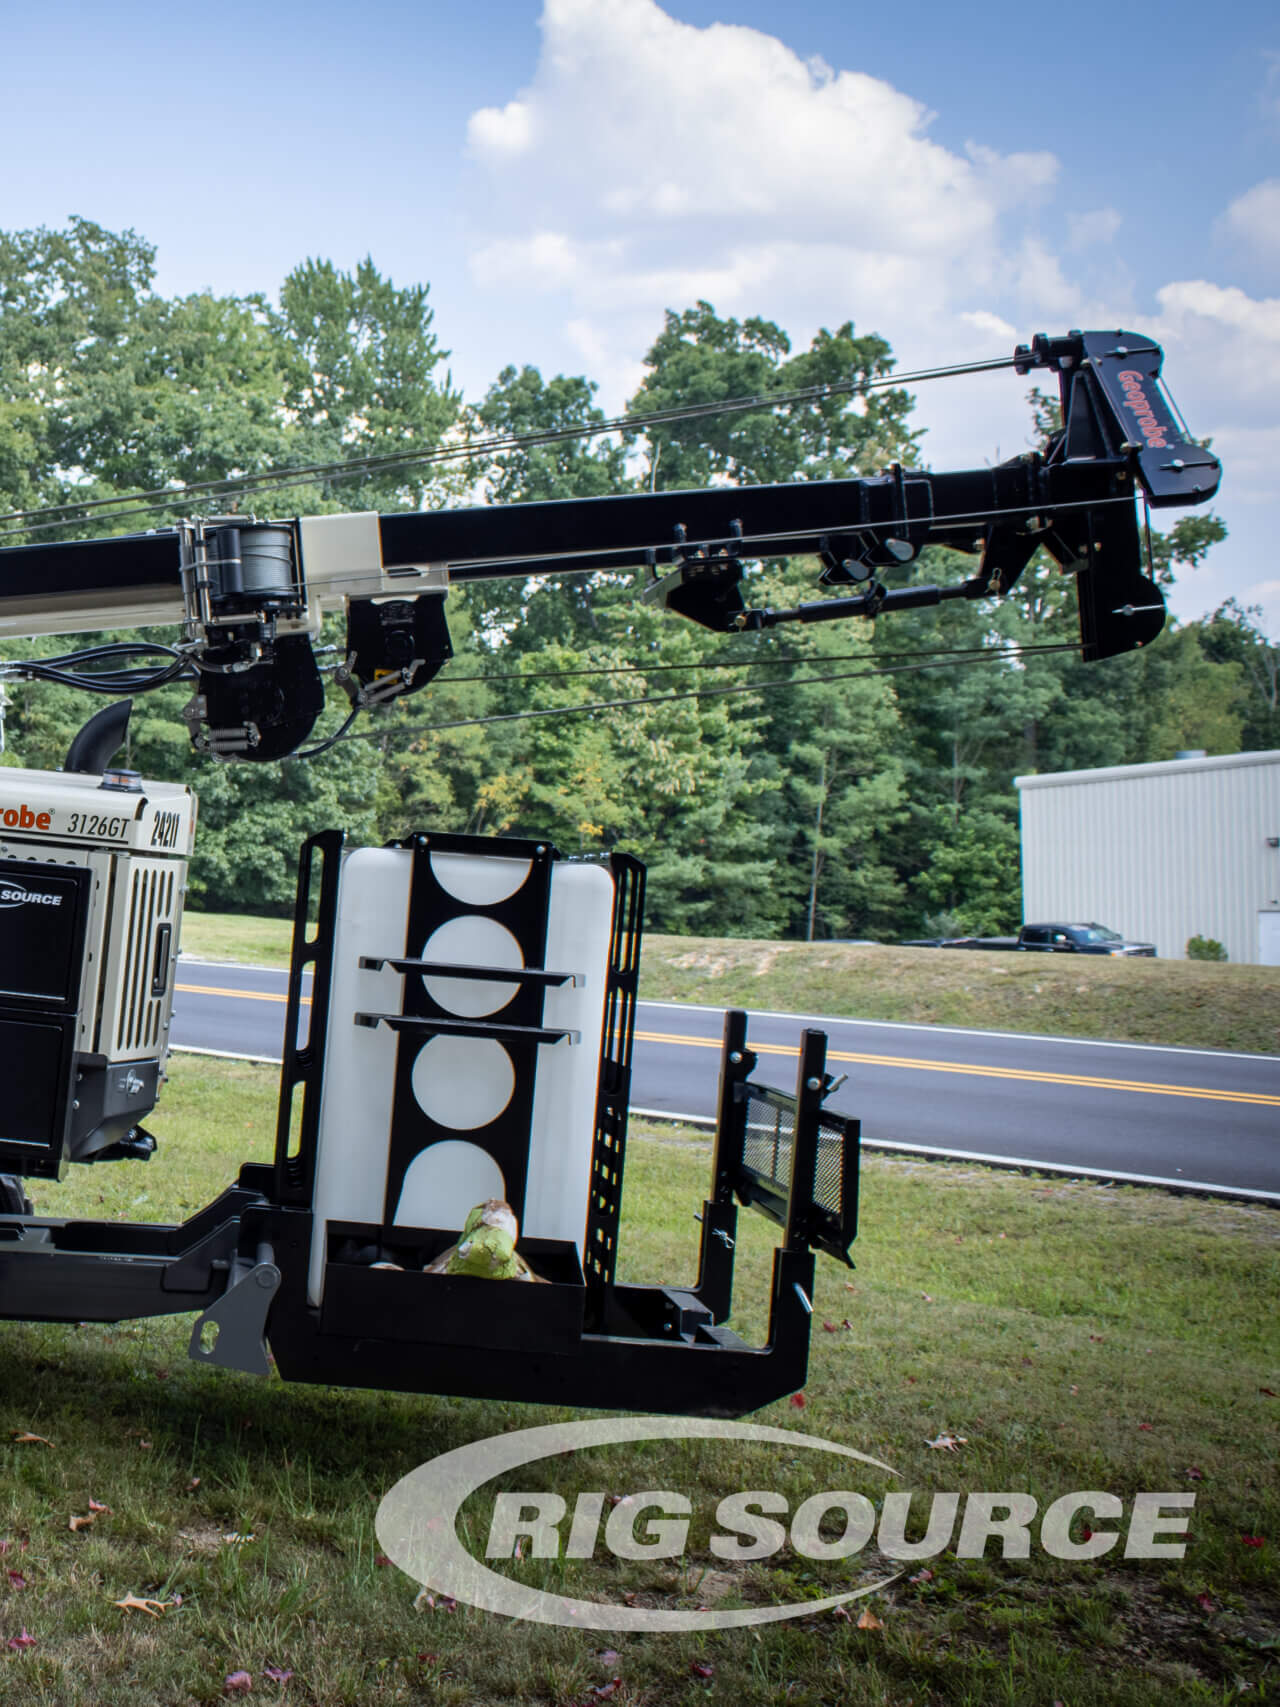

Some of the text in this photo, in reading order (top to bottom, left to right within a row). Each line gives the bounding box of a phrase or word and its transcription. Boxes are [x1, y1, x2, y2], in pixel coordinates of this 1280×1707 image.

[1118, 369, 1167, 449] Geoprobe
[67, 813, 131, 838] 3126GT
[1, 890, 63, 906] SOURCE
